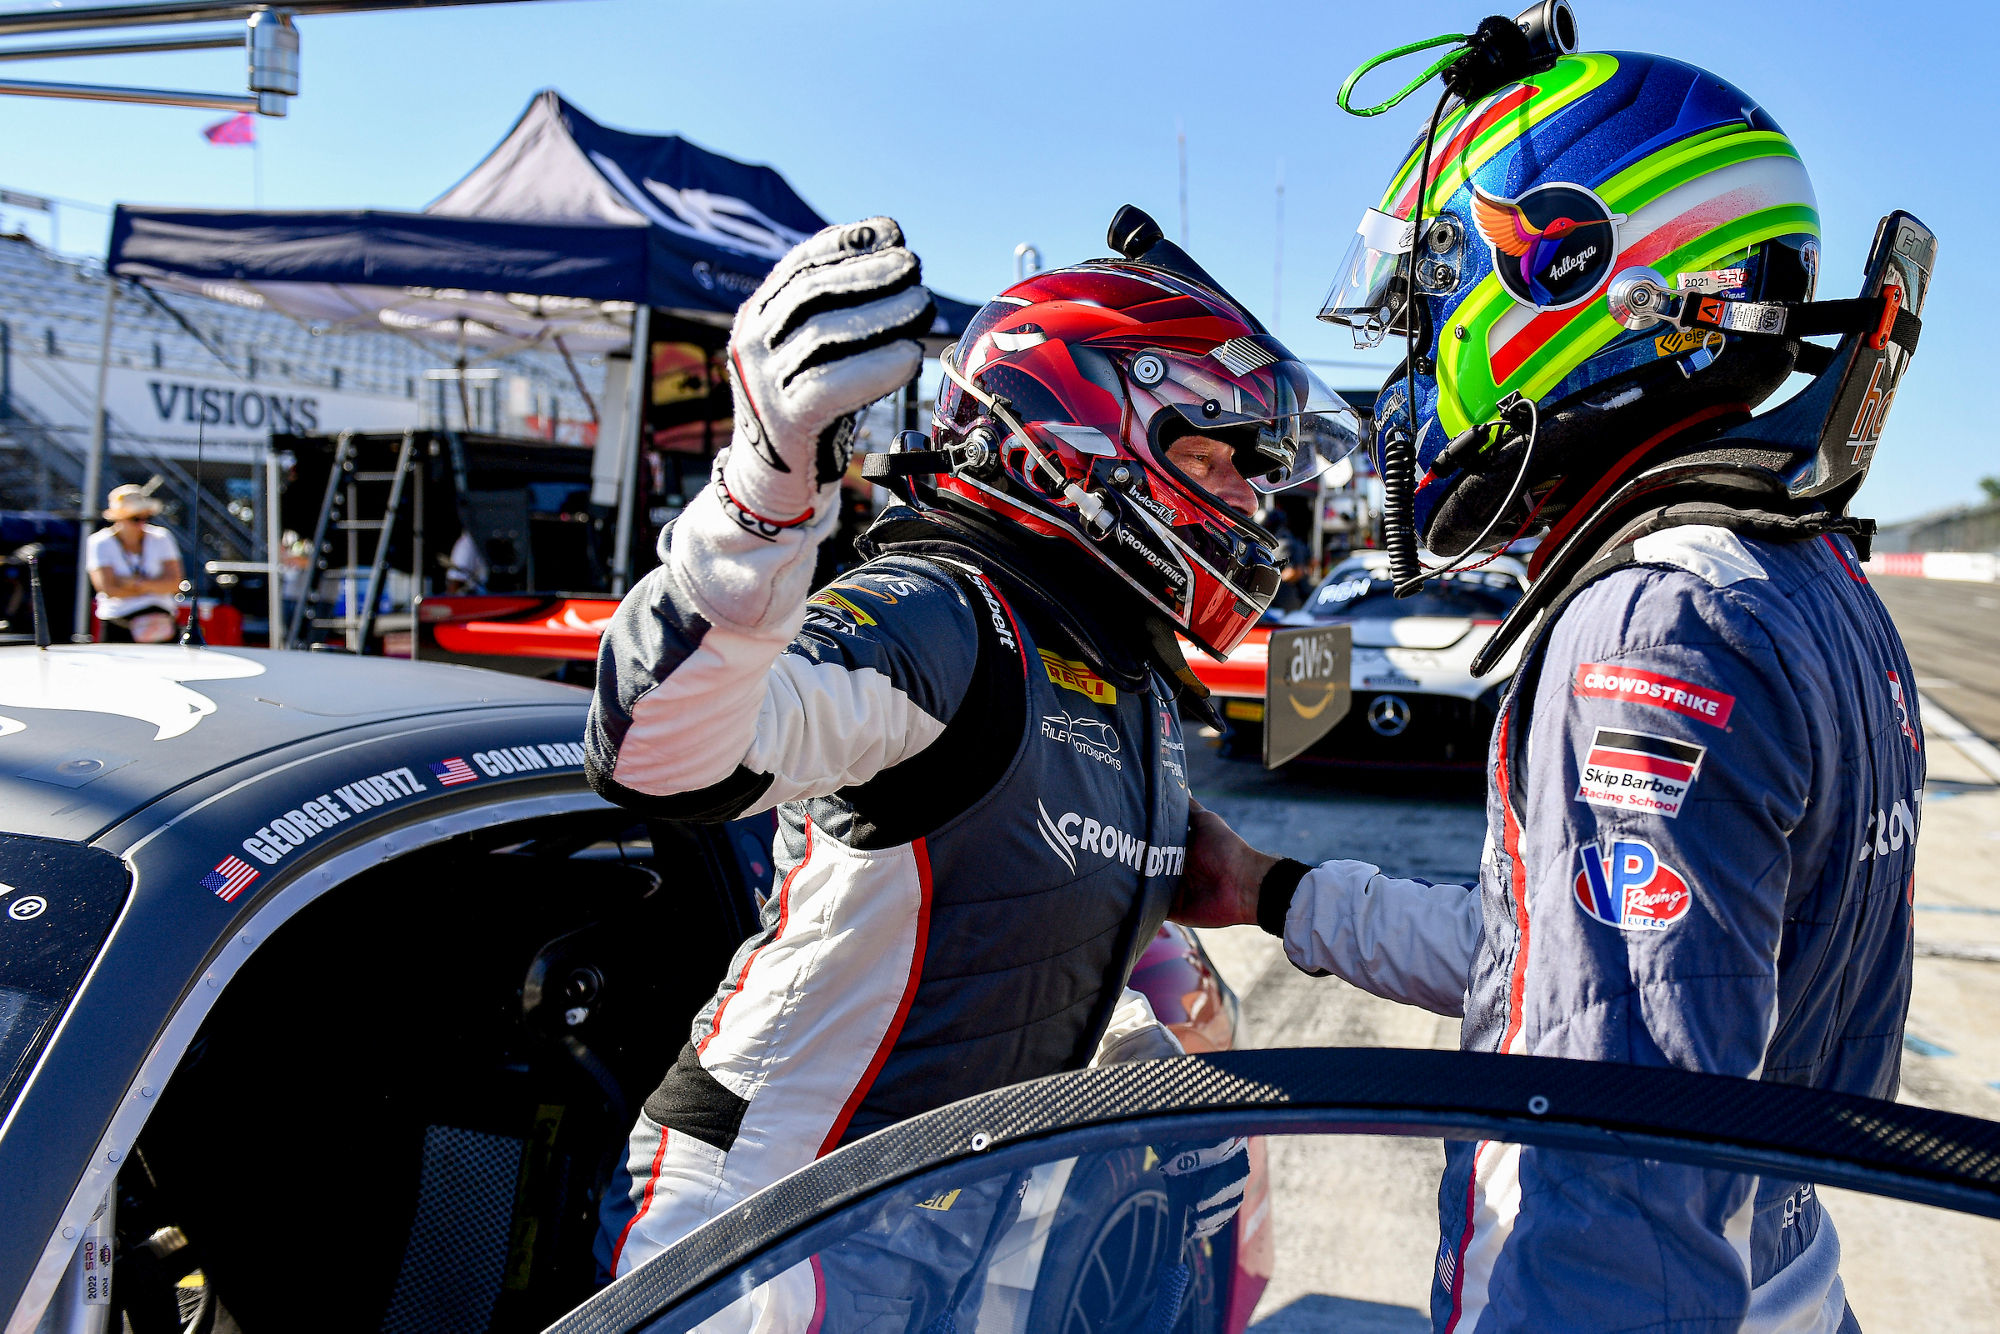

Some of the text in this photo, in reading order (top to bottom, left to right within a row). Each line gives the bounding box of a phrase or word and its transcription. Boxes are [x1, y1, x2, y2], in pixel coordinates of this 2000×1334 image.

[1684, 277, 1709, 288] 2021
[149, 381, 318, 437] VISIONS
[1120, 529, 1187, 587] CROWDSTRIKE
[965, 572, 1016, 653] Sabelt
[1047, 664, 1104, 696] RELLI
[1584, 672, 1720, 717] CROWDSTRIKE
[1041, 721, 1073, 744] RILEY
[472, 741, 585, 778] COLIN BRA
[1584, 768, 1684, 798] Skip Barber
[1579, 786, 1679, 813] Racing School
[242, 767, 427, 865] GEORGE KURTZ
[1581, 841, 1657, 926] VP
[1626, 888, 1688, 914] Racing
[1628, 916, 1666, 928] FUELS
[87, 1275, 97, 1299] 2022
